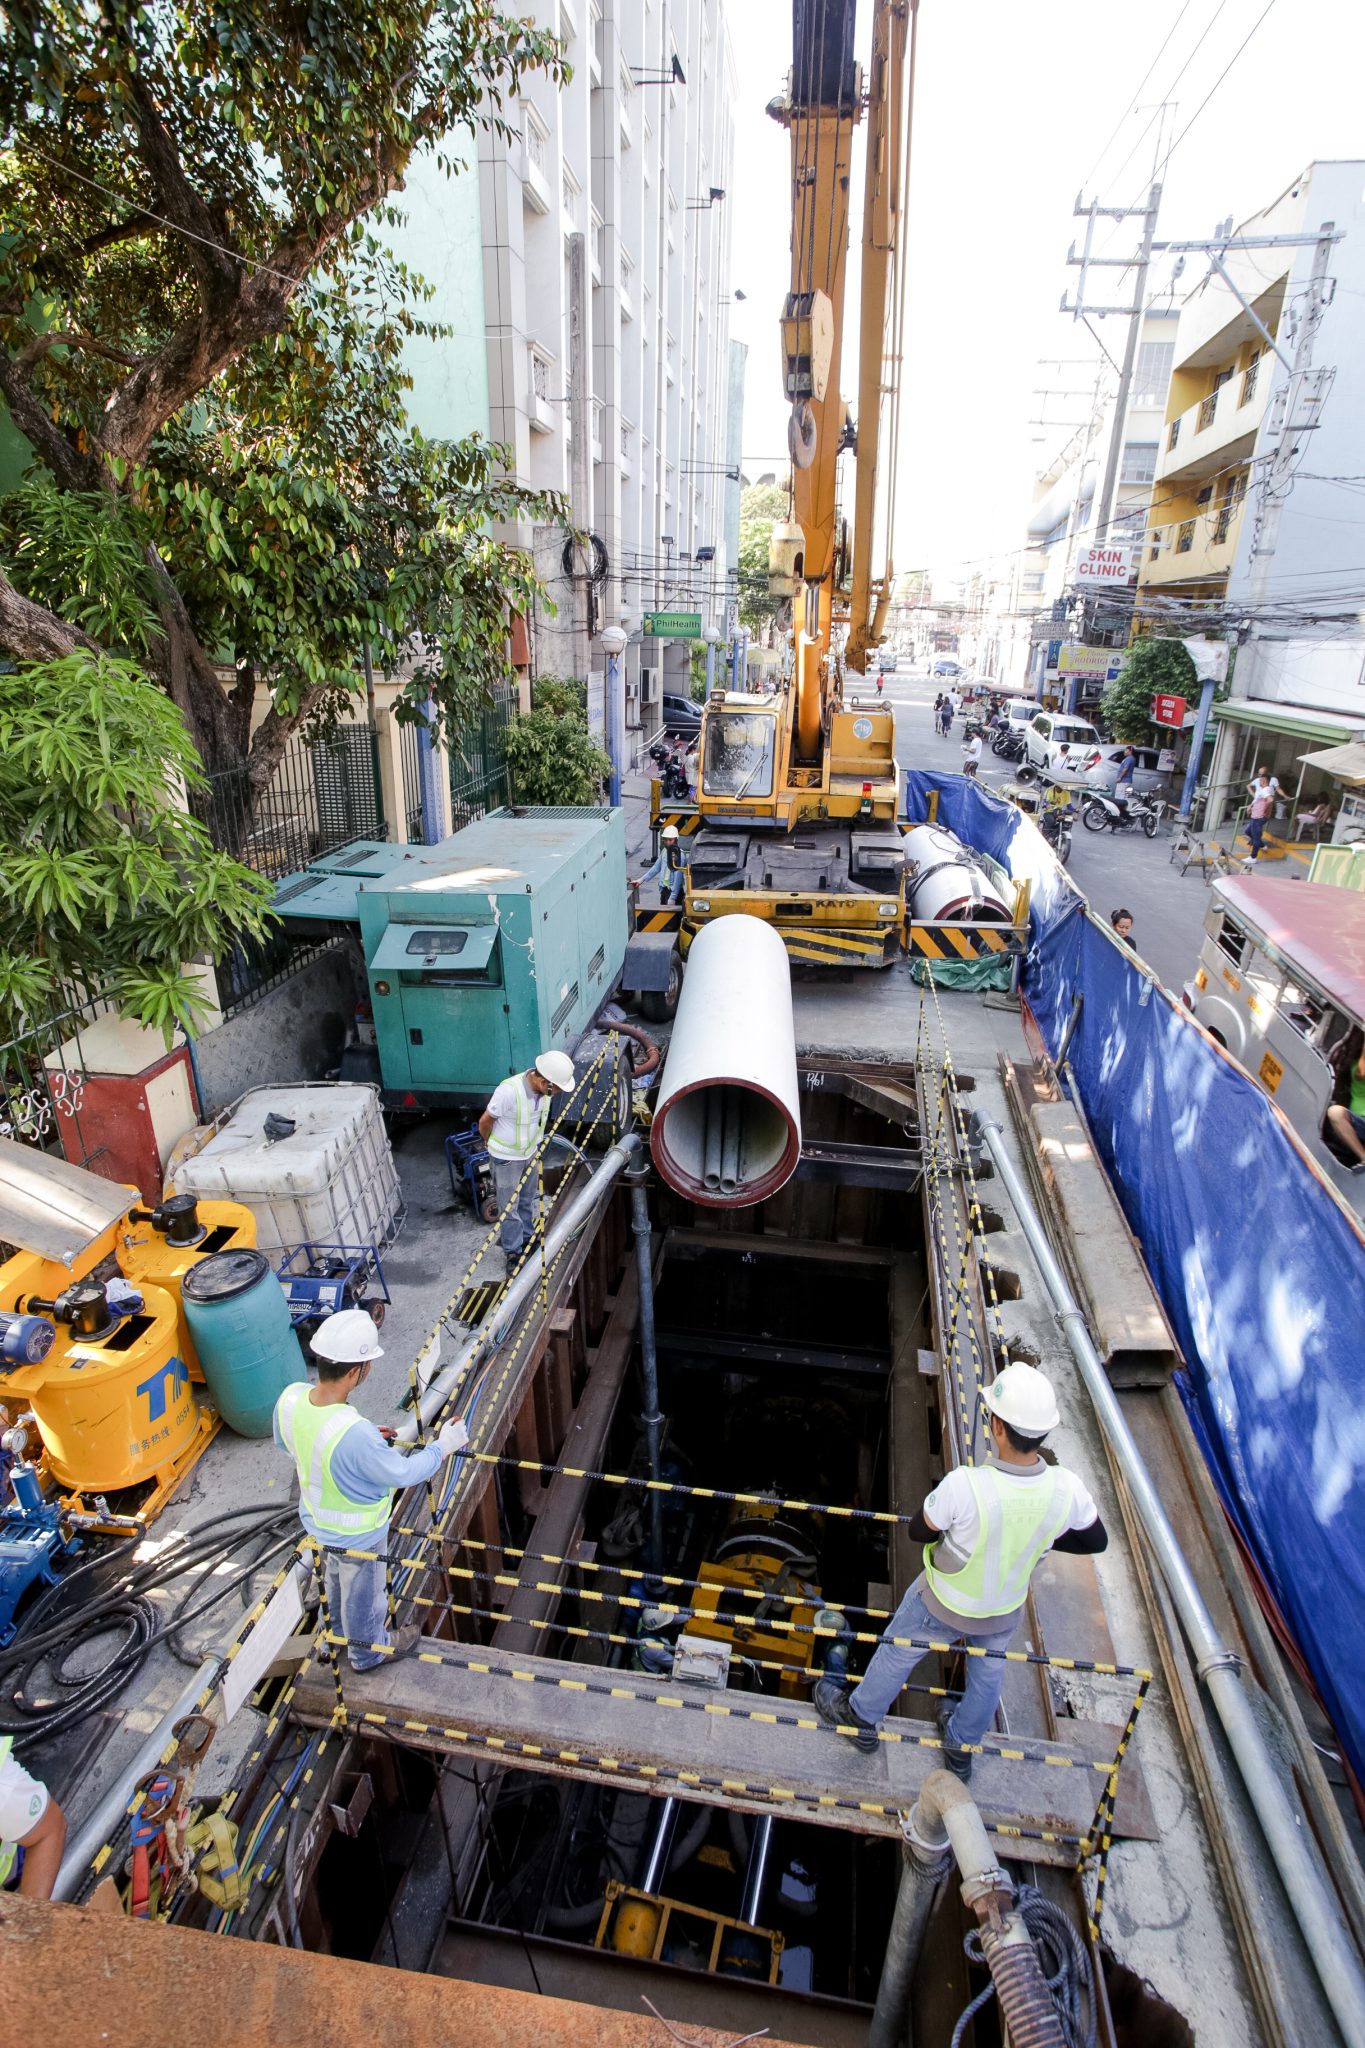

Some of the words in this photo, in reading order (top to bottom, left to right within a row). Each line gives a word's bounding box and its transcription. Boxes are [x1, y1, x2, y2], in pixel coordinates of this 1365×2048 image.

[1088, 550, 1122, 562] SKIN
[1079, 563, 1127, 576] CLINIC
[656, 619, 700, 629] PhilHealth
[815, 899, 855, 909] KATO
